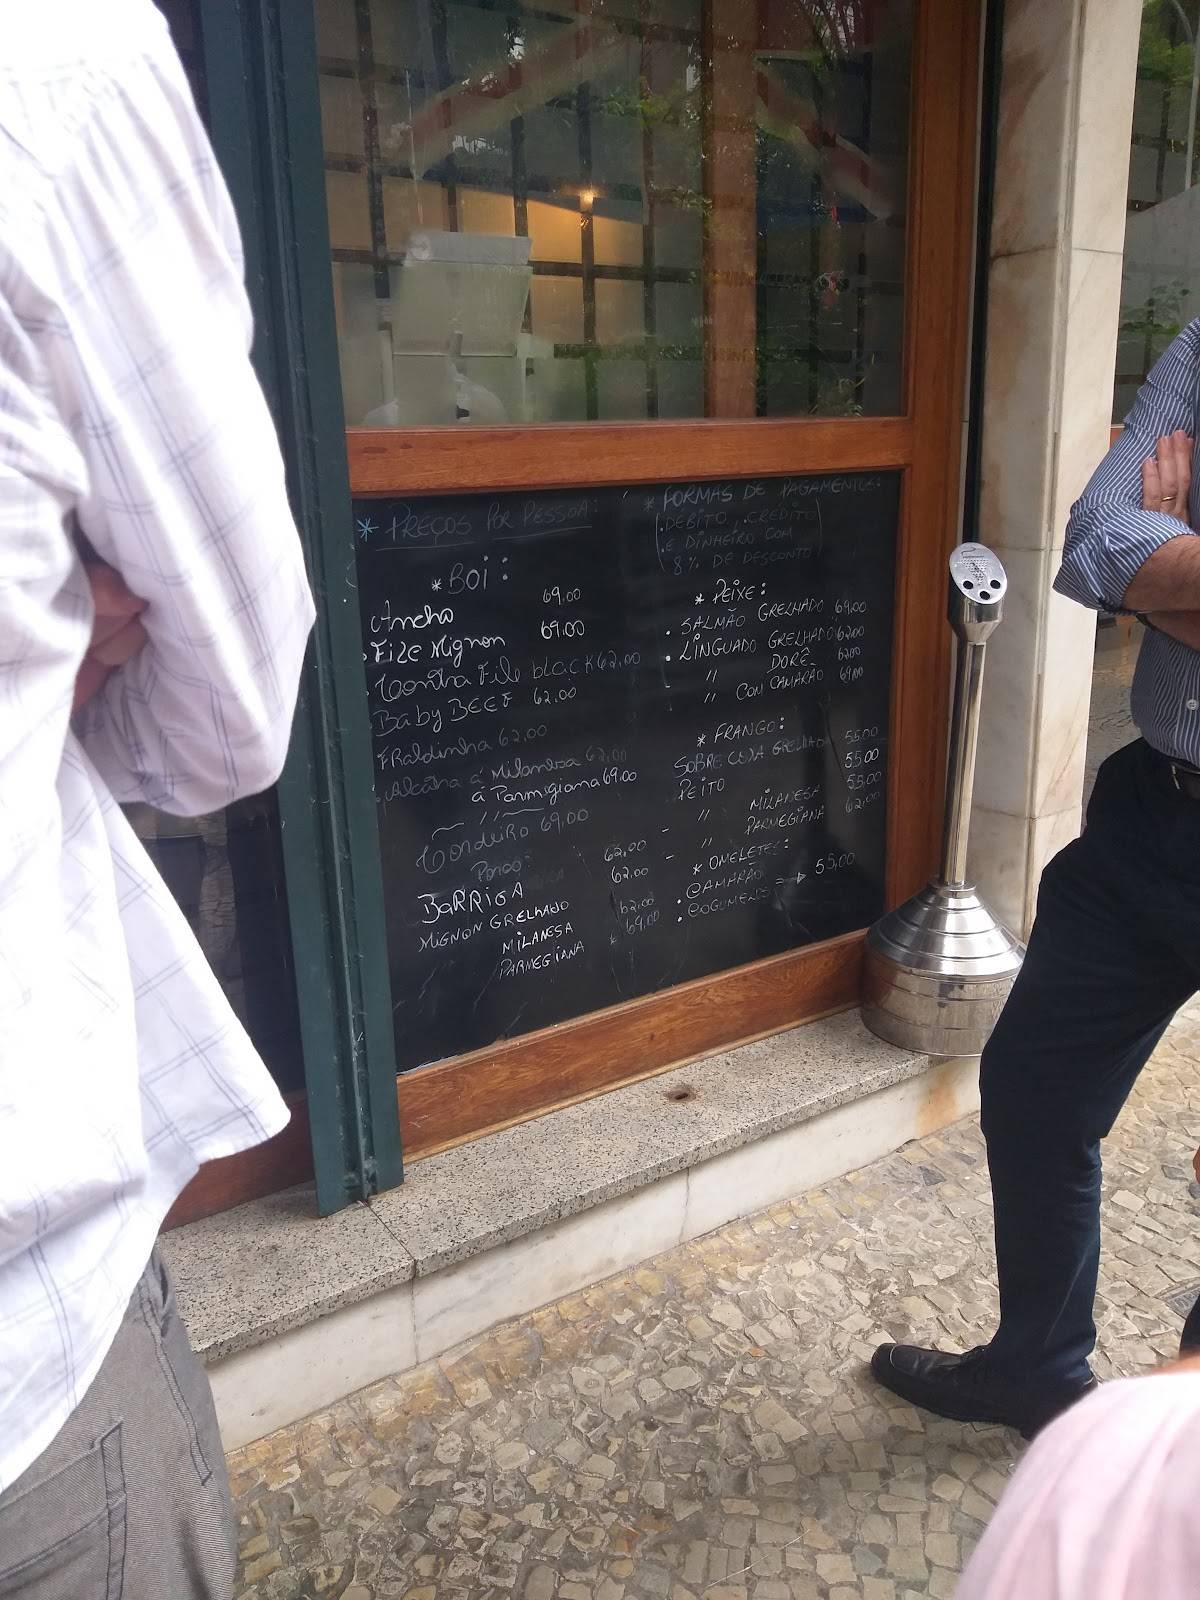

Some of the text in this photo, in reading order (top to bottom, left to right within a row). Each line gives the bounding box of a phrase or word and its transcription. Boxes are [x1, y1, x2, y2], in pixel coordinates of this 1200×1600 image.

[663, 484, 733, 512] FORMAS
[743, 482, 766, 500] DE
[385, 503, 472, 544] PREÇOS
[681, 608, 745, 636] SALMÃO
[758, 598, 824, 622] GRELHADO
[679, 633, 757, 661] LINGUADO
[767, 626, 834, 649] GRELHADO
[502, 922, 574, 954] MILANESA
